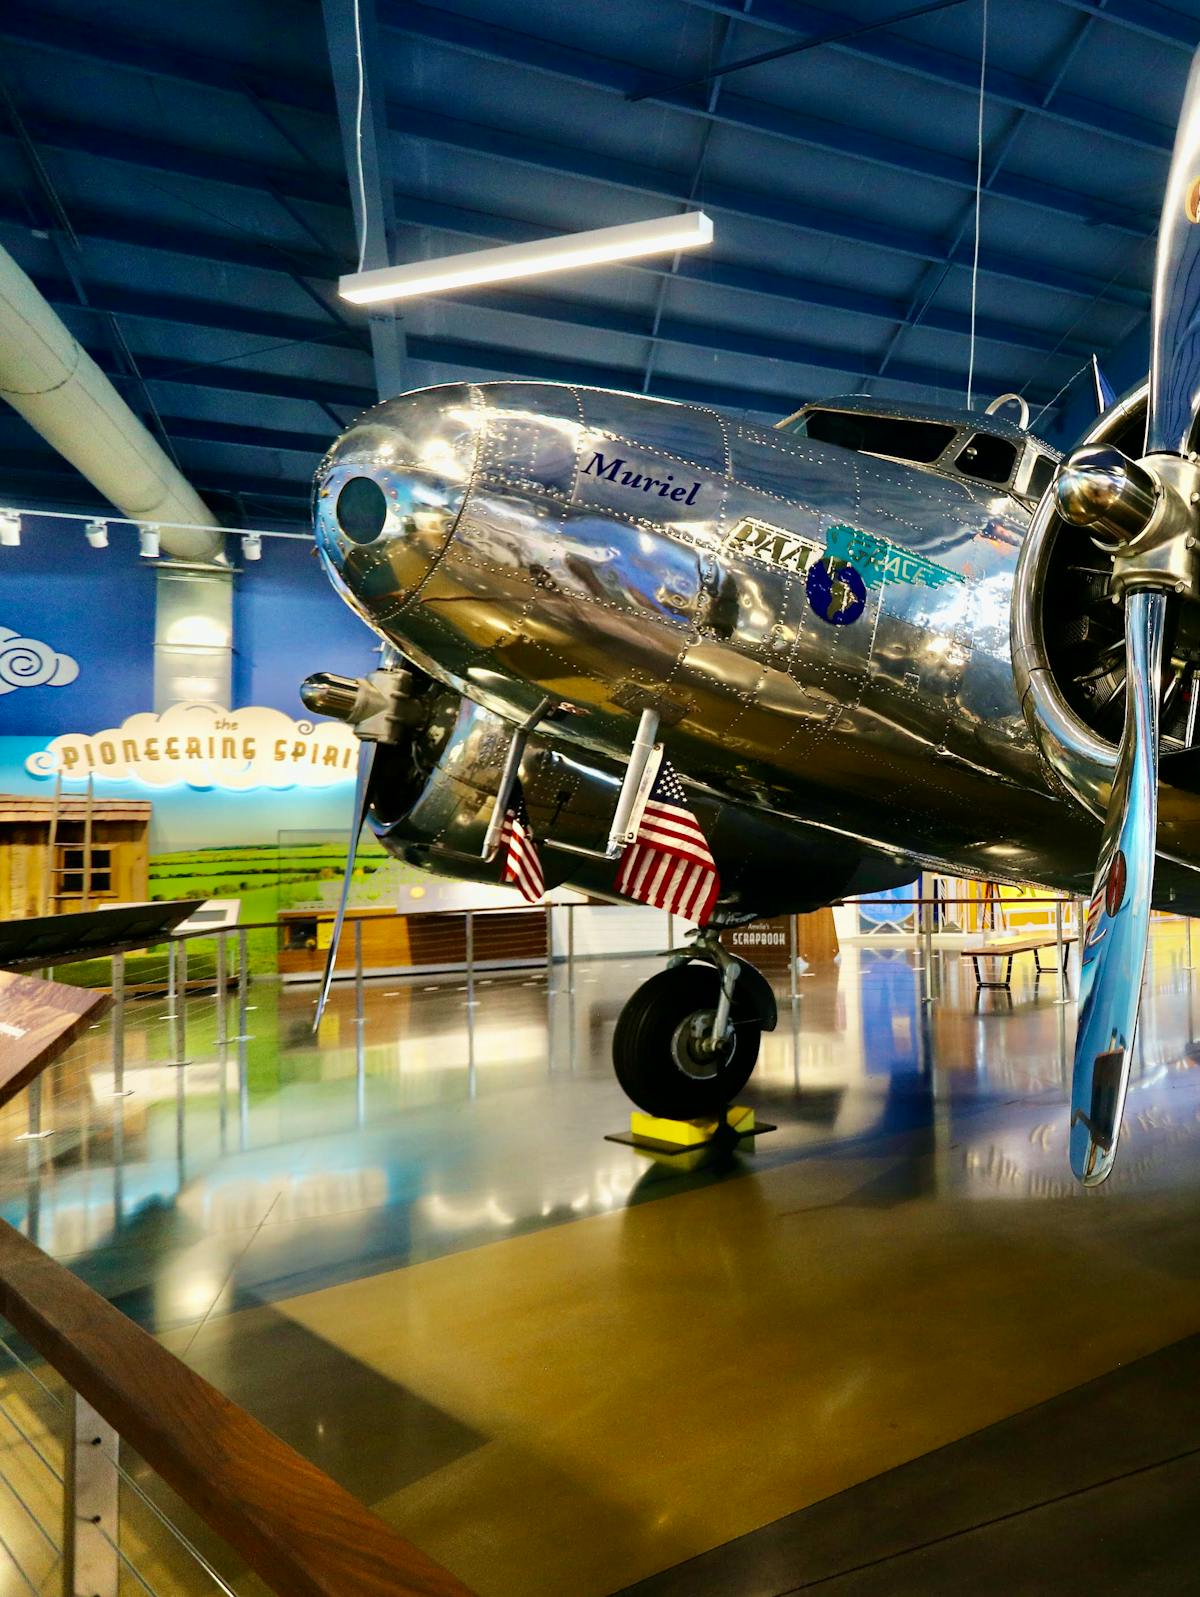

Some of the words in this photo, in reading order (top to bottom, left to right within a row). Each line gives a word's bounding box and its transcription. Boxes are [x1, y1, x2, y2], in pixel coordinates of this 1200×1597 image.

[581, 452, 702, 506] Muriel
[729, 524, 814, 576] PAA
[214, 718, 238, 731] the
[62, 737, 256, 769] PIONEERING
[274, 739, 359, 769] SPIRI
[732, 932, 786, 945] SCRAPBOOK
